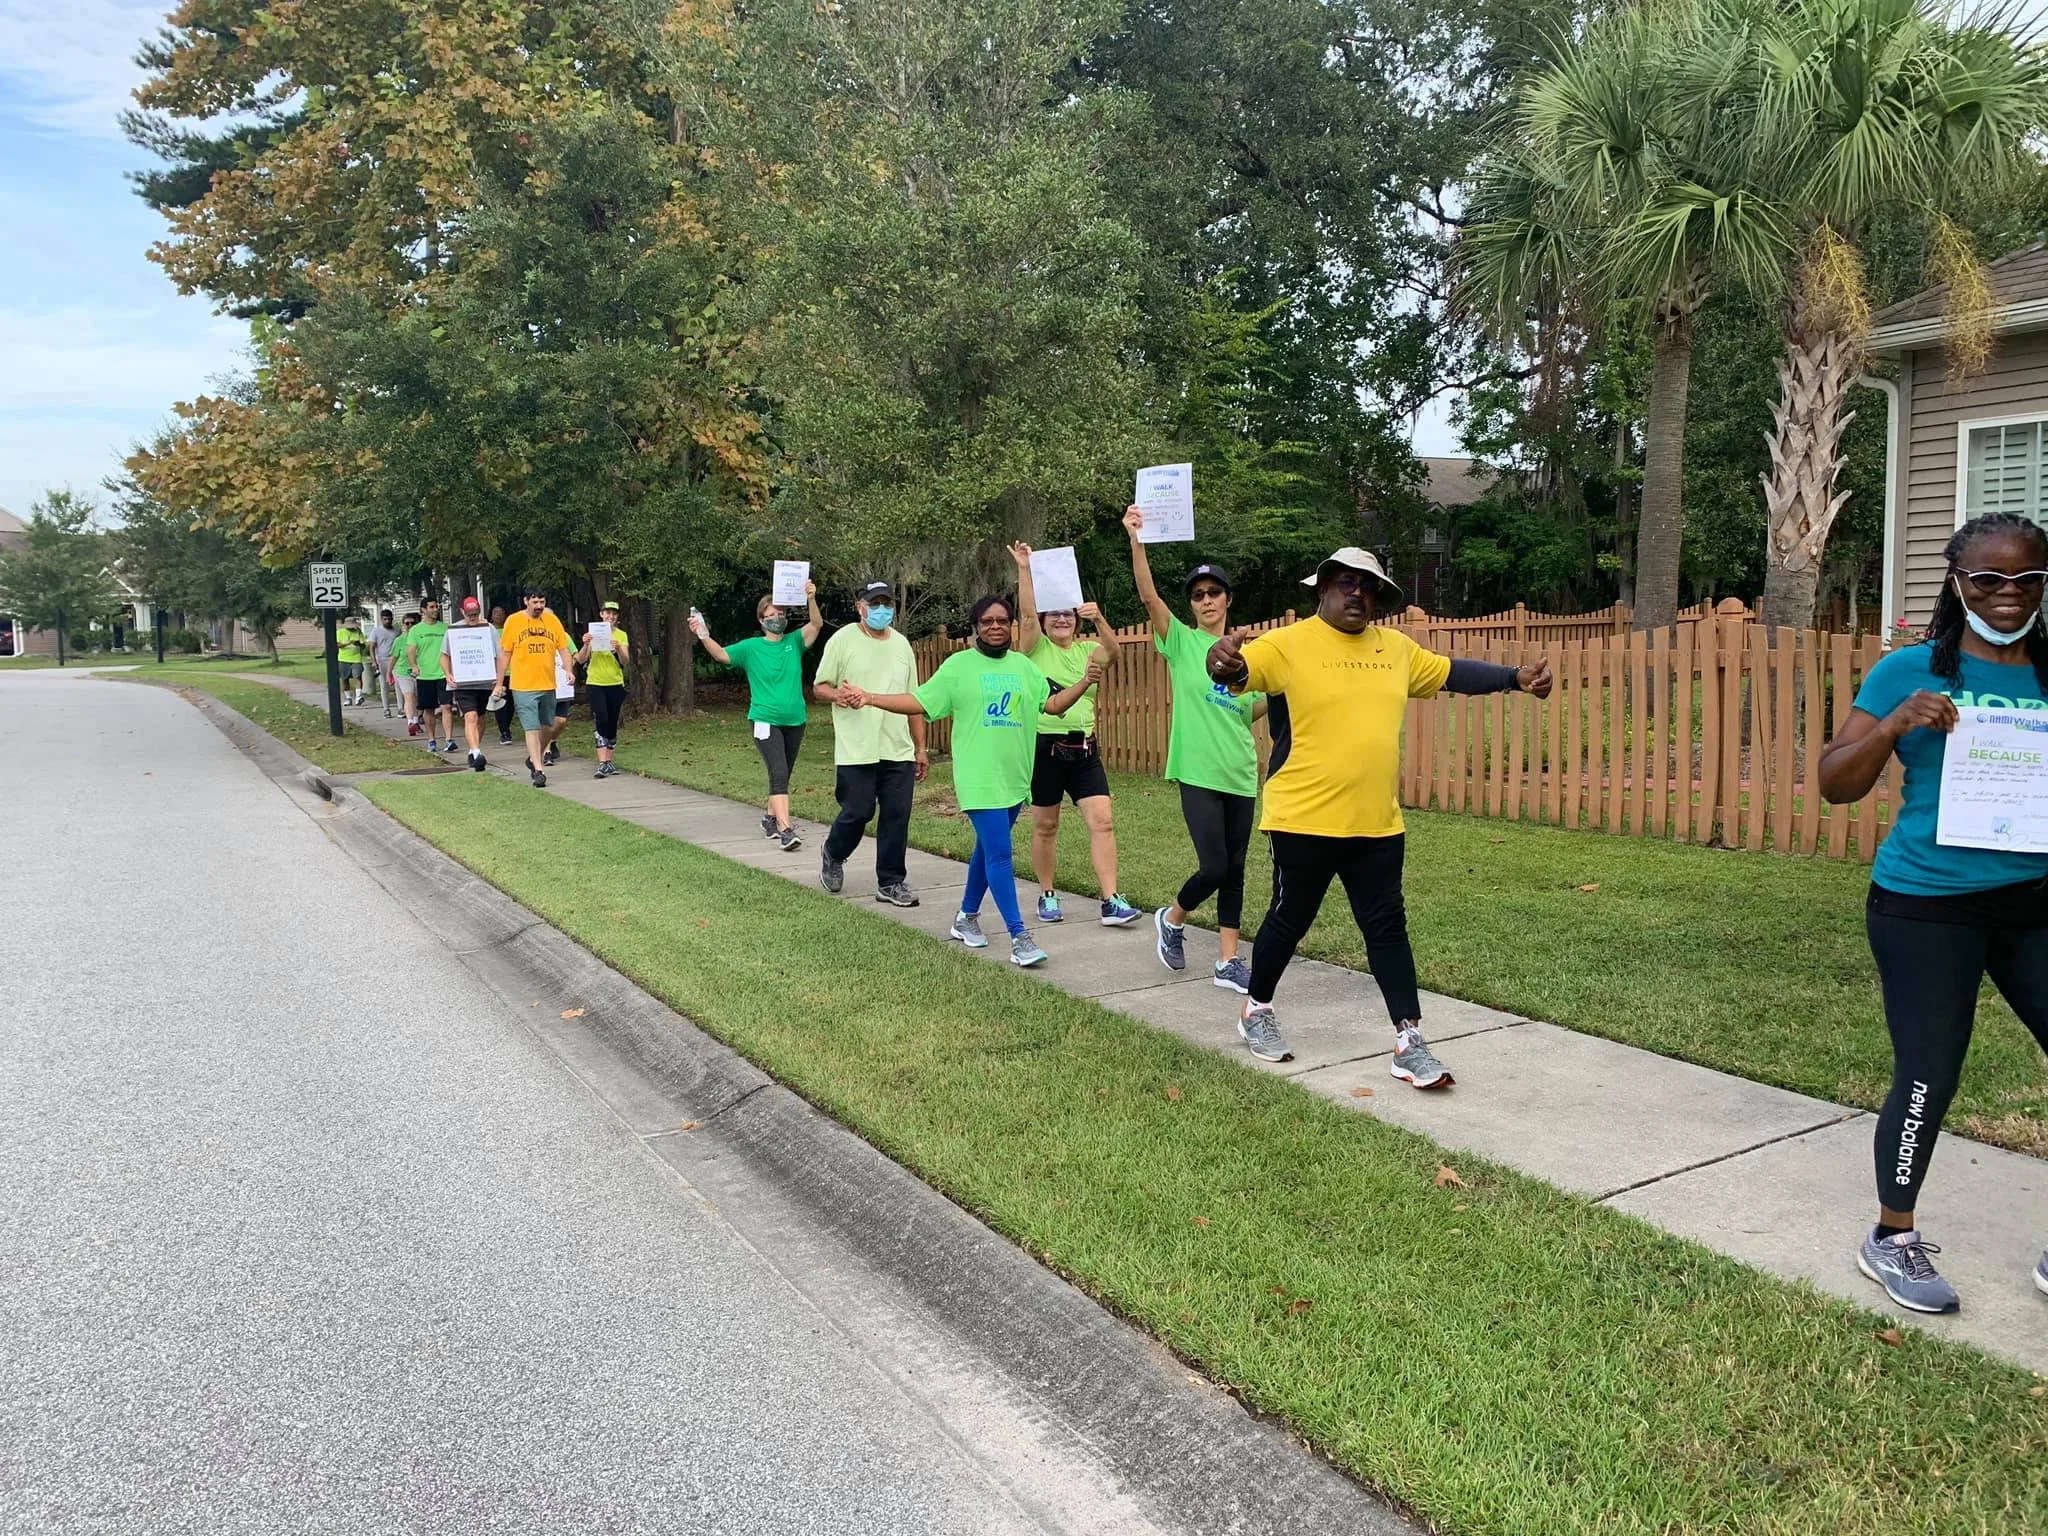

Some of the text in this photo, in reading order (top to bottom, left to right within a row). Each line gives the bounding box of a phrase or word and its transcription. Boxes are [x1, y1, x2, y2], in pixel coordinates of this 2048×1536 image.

[316, 576, 340, 584] LIMIT
[315, 586, 344, 602] 25
[528, 643, 545, 653] STATE
[1321, 660, 1392, 669] LIVESTRONG
[1968, 749, 2042, 763] BECAUSE
[1896, 1080, 1928, 1185] new balance
